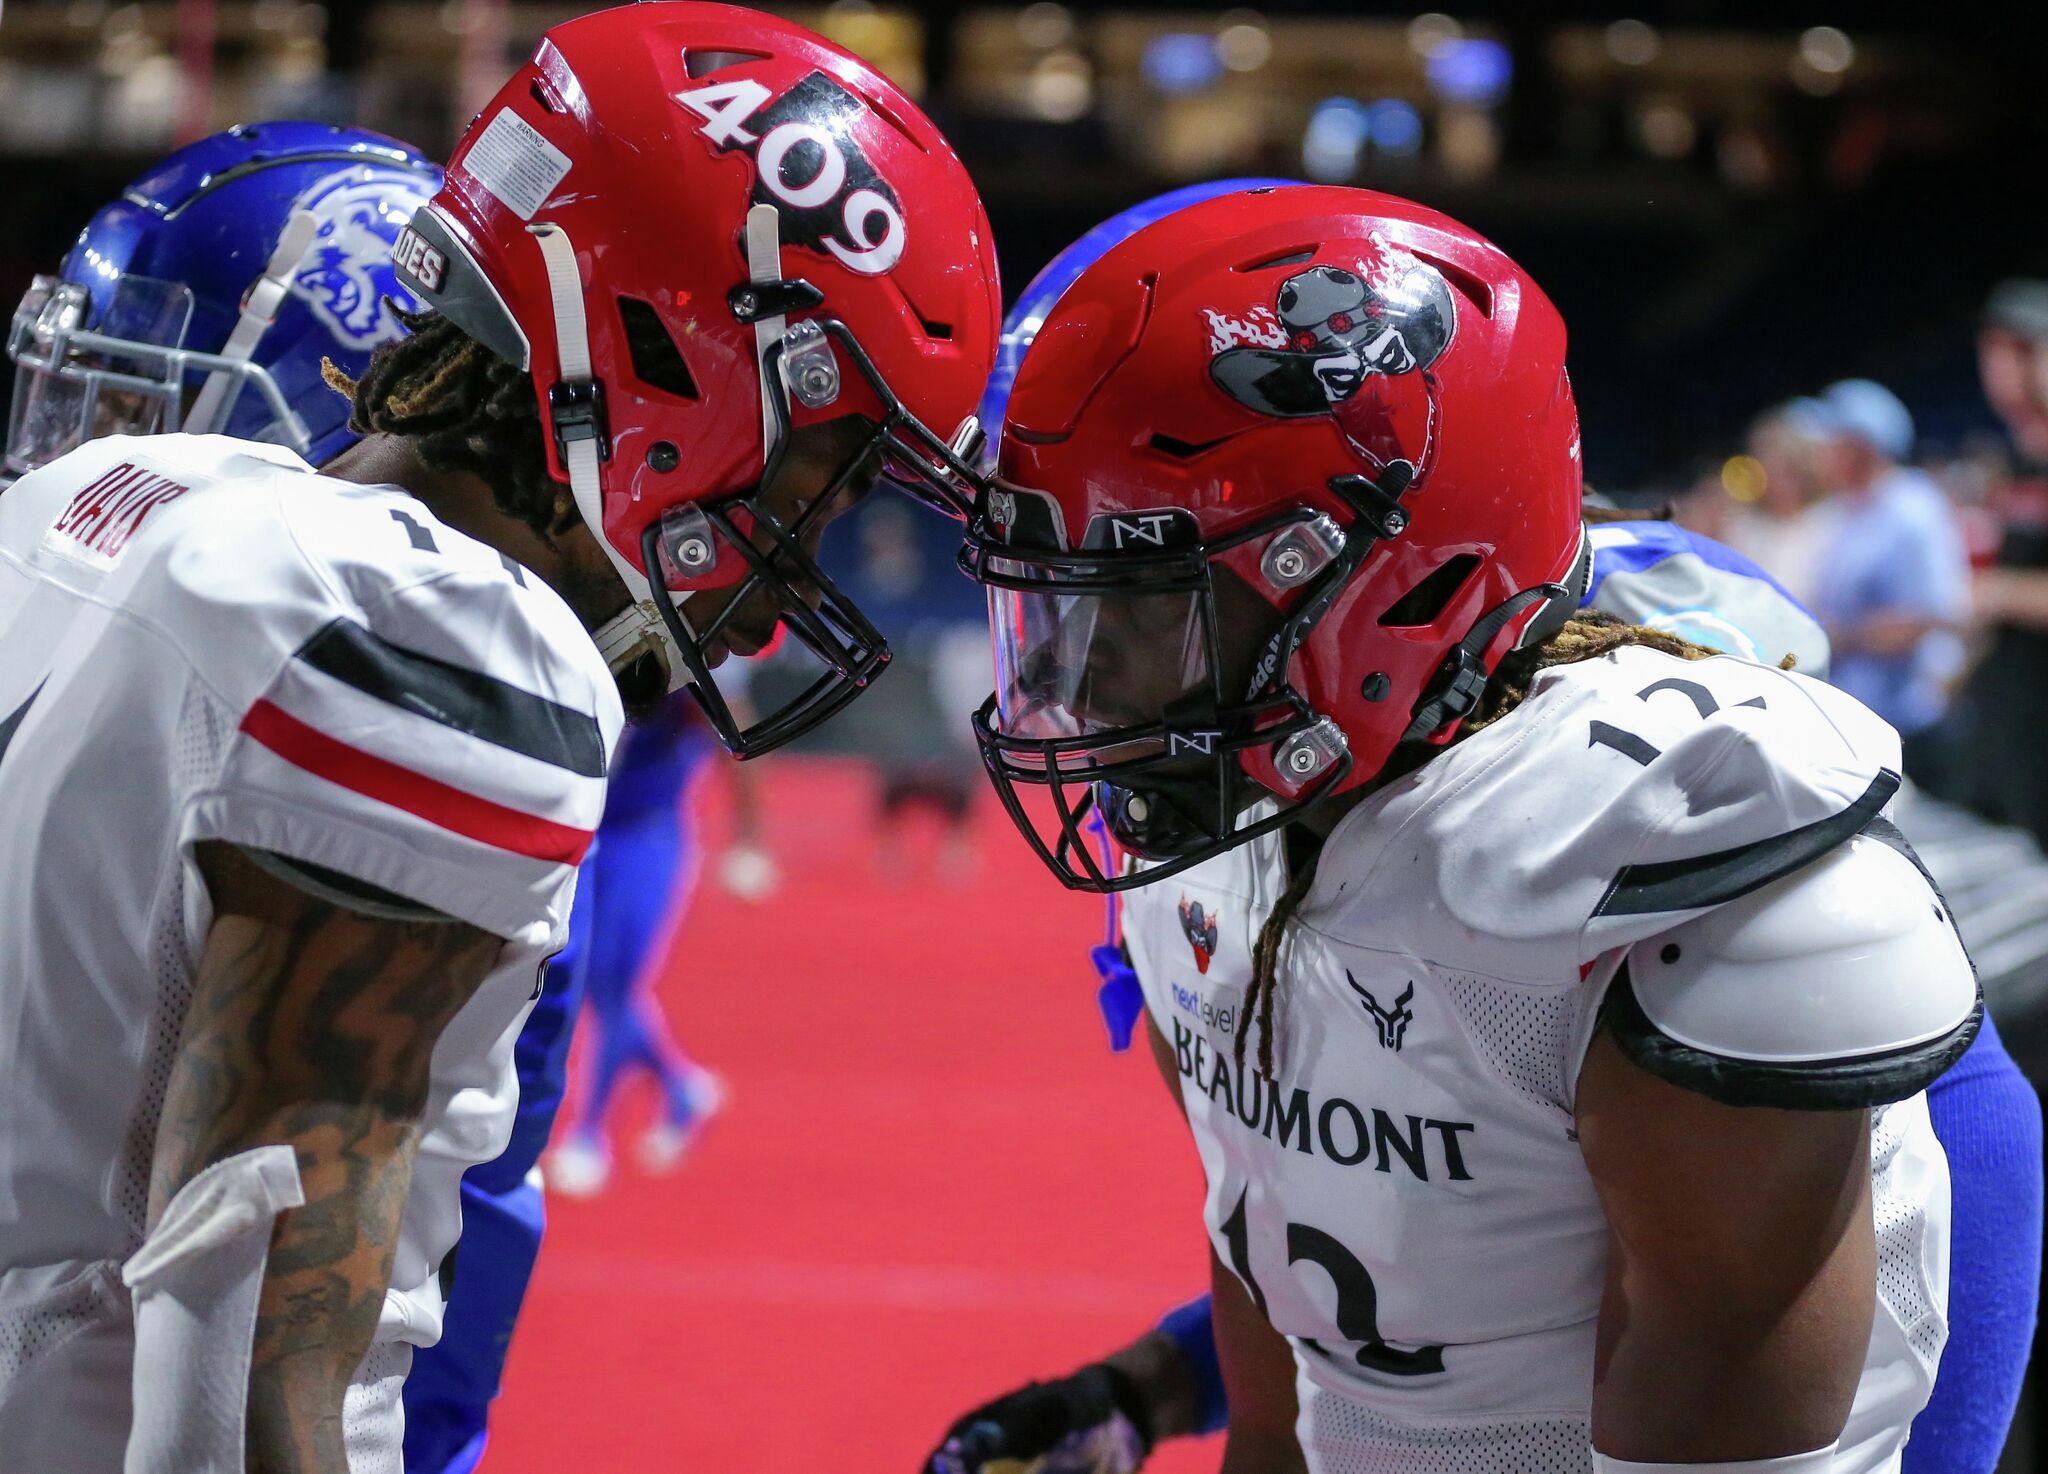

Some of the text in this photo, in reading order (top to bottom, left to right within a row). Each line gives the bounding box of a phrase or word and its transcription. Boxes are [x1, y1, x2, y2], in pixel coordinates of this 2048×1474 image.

[516, 122, 545, 148] WARNING
[674, 79, 904, 273] 409
[54, 463, 190, 557] DAVIS
[1588, 678, 1767, 767] 12
[1172, 1015, 1475, 1182] BEAUMONT
[1220, 1180, 1446, 1376] 12
